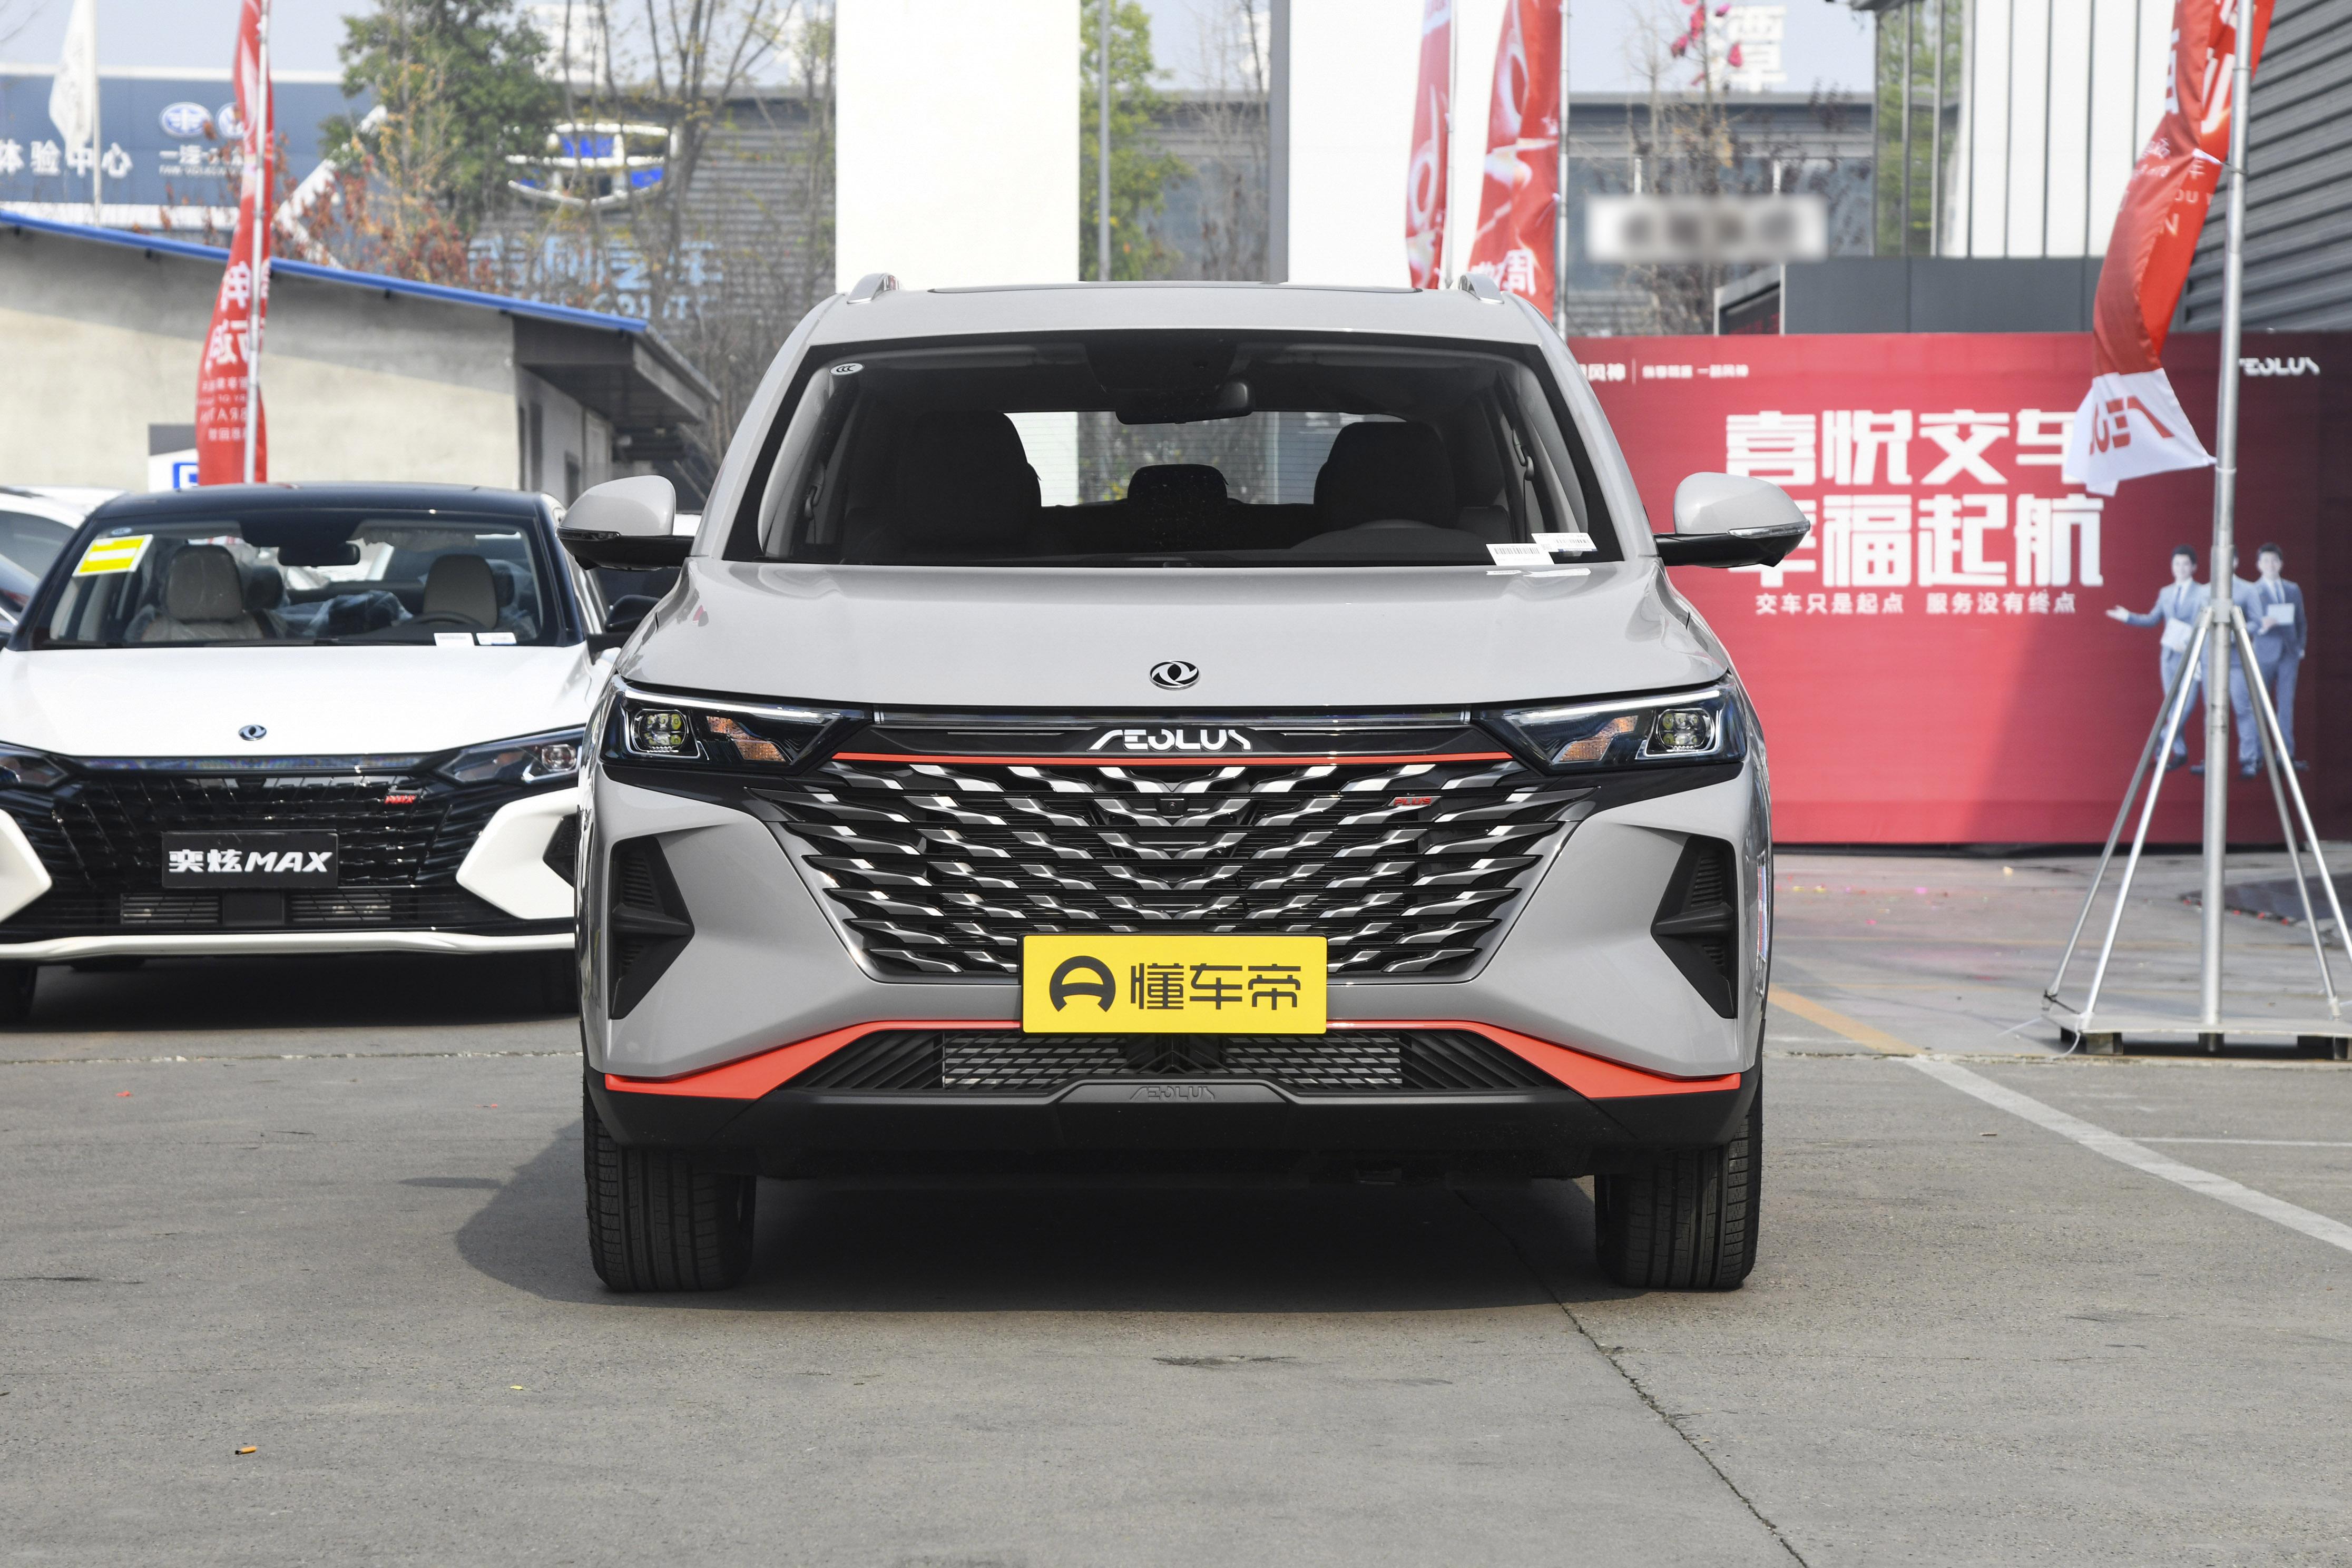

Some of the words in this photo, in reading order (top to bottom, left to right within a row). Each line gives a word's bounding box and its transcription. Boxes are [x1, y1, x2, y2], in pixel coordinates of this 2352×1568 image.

[1726, 409, 2084, 485] 喜悦交车
[1756, 592, 1904, 615] 交车只是起点
[1926, 591, 2077, 615] 服务没有终点
[1085, 729, 1252, 752] AEOLUS
[1393, 797, 1432, 807] PLUS
[1130, 963, 1301, 1011] 懂车帝
[1129, 1085, 1216, 1102] AEOLUS
